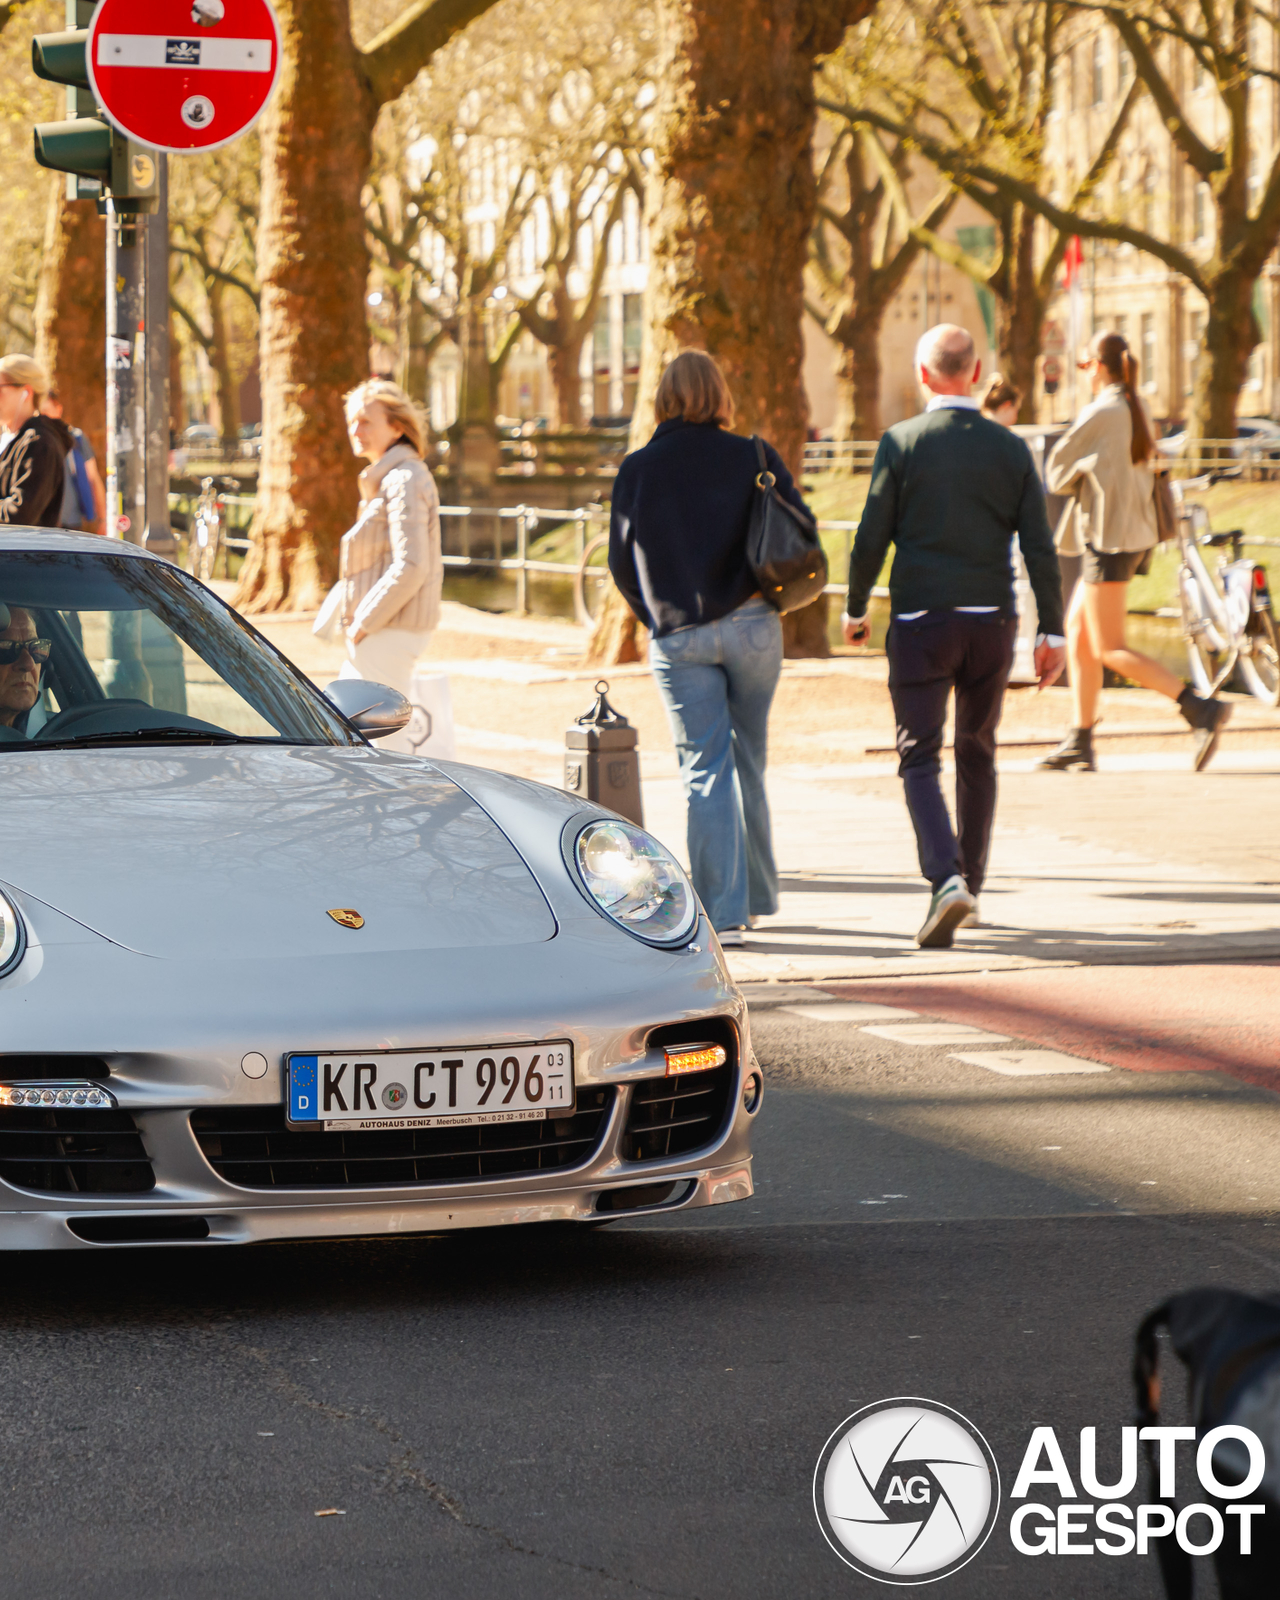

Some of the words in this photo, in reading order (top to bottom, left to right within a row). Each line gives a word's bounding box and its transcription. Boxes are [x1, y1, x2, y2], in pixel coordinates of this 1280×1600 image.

[547, 1053, 564, 1067] 03
[323, 1062, 378, 1112] KR
[413, 1059, 464, 1109] CT
[476, 1054, 544, 1106] 996
[549, 1085, 564, 1100] 11
[298, 1095, 309, 1110] D
[360, 1120, 405, 1129] AUTOHAUS
[406, 1119, 431, 1127] DENIZ
[436, 1117, 472, 1125] Meerbusch
[477, 1115, 491, 1123] Tel.:
